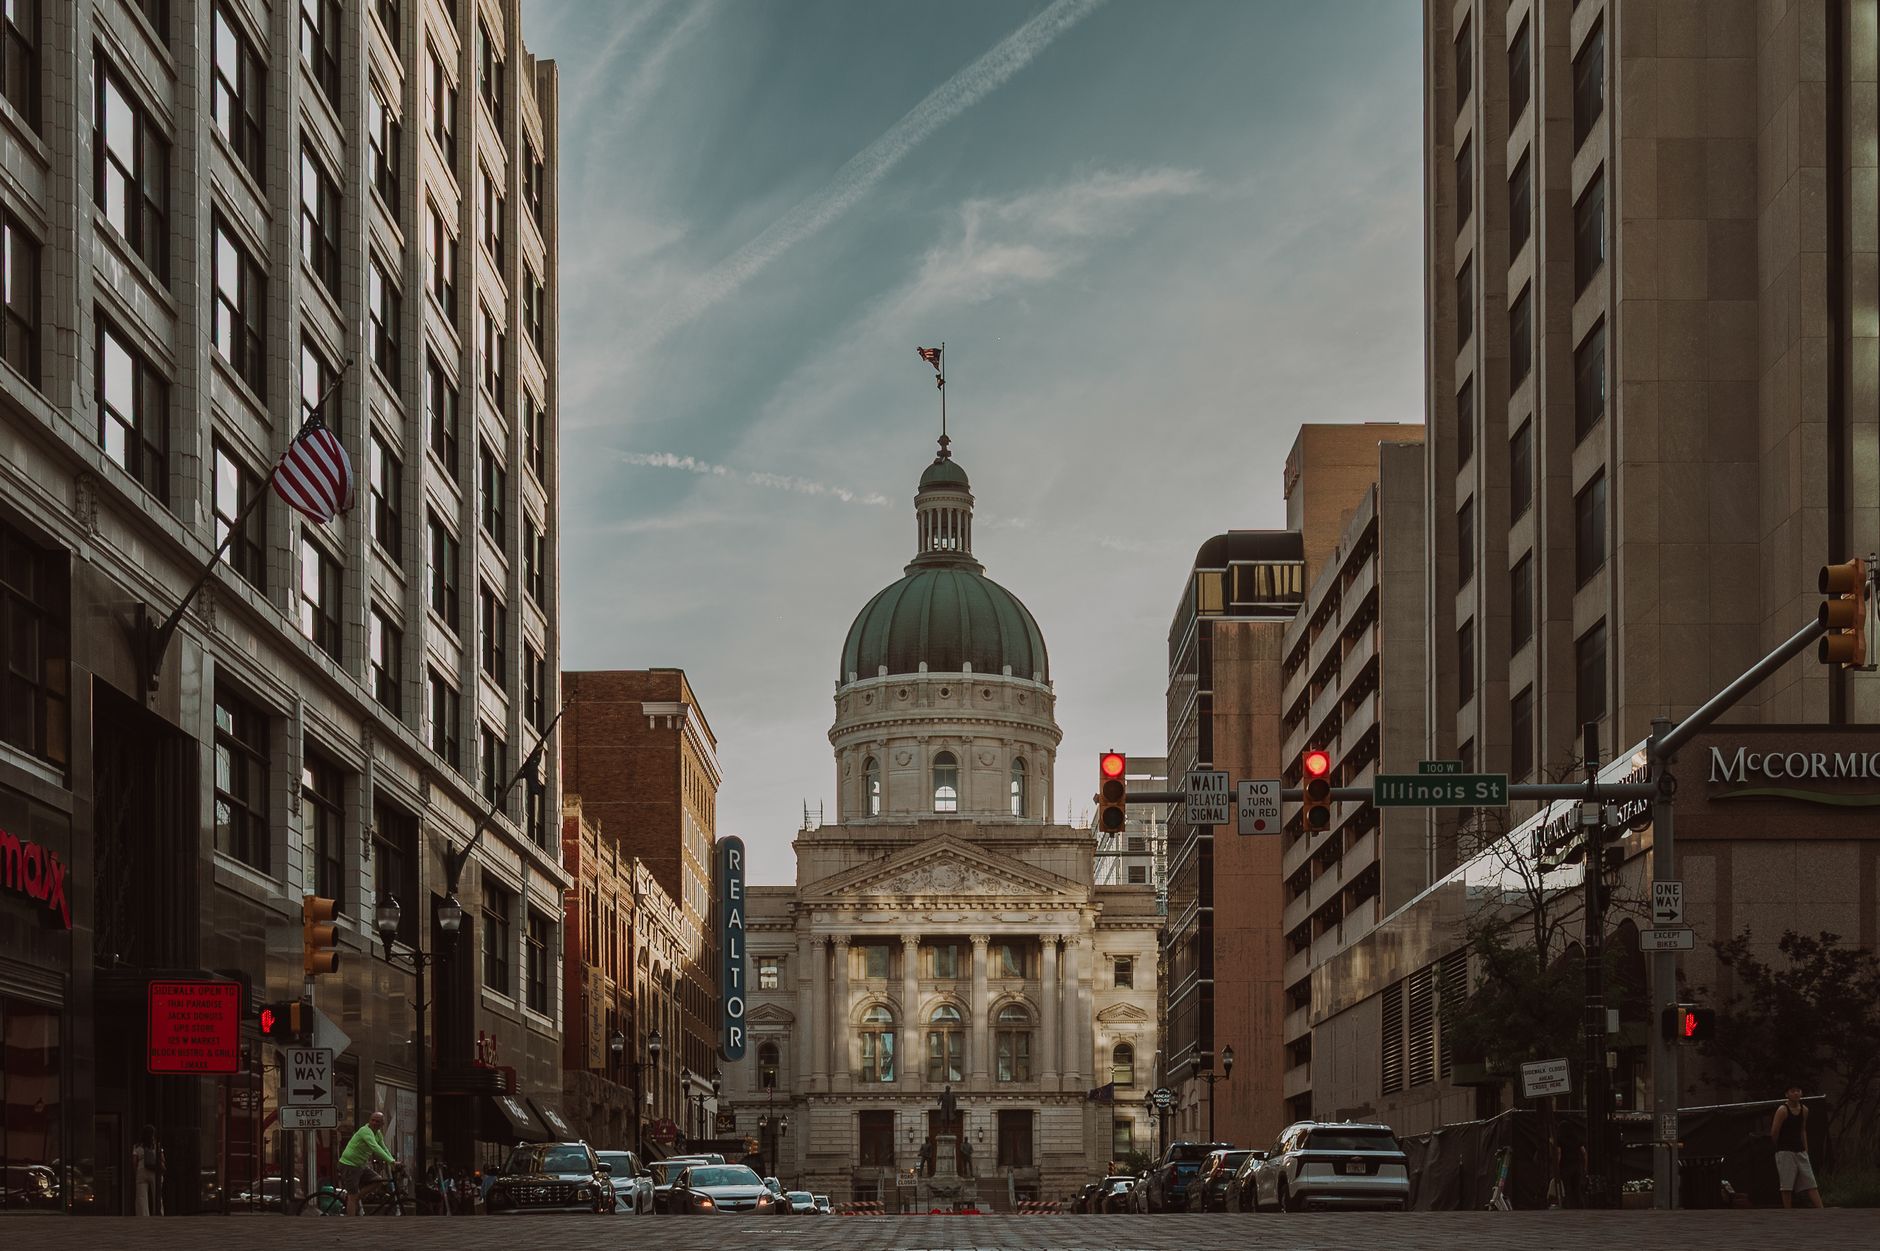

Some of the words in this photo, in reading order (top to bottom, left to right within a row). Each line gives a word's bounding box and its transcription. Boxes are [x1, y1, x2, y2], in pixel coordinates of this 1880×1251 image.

[1426, 763, 1443, 773] 100
[1446, 763, 1455, 773] W
[1191, 775, 1224, 791] WAIT
[1249, 784, 1269, 795] NO
[1382, 782, 1466, 799] Illinois
[1475, 782, 1500, 799] St
[1187, 793, 1228, 806] DELAYED
[1247, 797, 1273, 806] TURN
[1191, 808, 1225, 821] SIGNAL
[1241, 809, 1255, 818] ON
[1259, 808, 1278, 817] RED
[1656, 884, 1679, 895] ONE
[1655, 896, 1679, 907] WAY
[1653, 931, 1680, 939] EXCEPT
[727, 848, 744, 1048] REALTOR
[153, 986, 195, 996] SIDEWALK
[198, 986, 222, 996] OPEN
[225, 987, 236, 997] TO
[168, 1000, 184, 1009] THAI
[186, 1000, 224, 1009] PARADISE
[192, 1024, 215, 1032] STORE
[191, 1036, 220, 1045] MARKET
[215, 1048, 235, 1057] GRILL
[294, 1051, 324, 1065] ONE
[294, 1067, 326, 1080] WAY
[295, 1109, 324, 1117] EXCEPT
